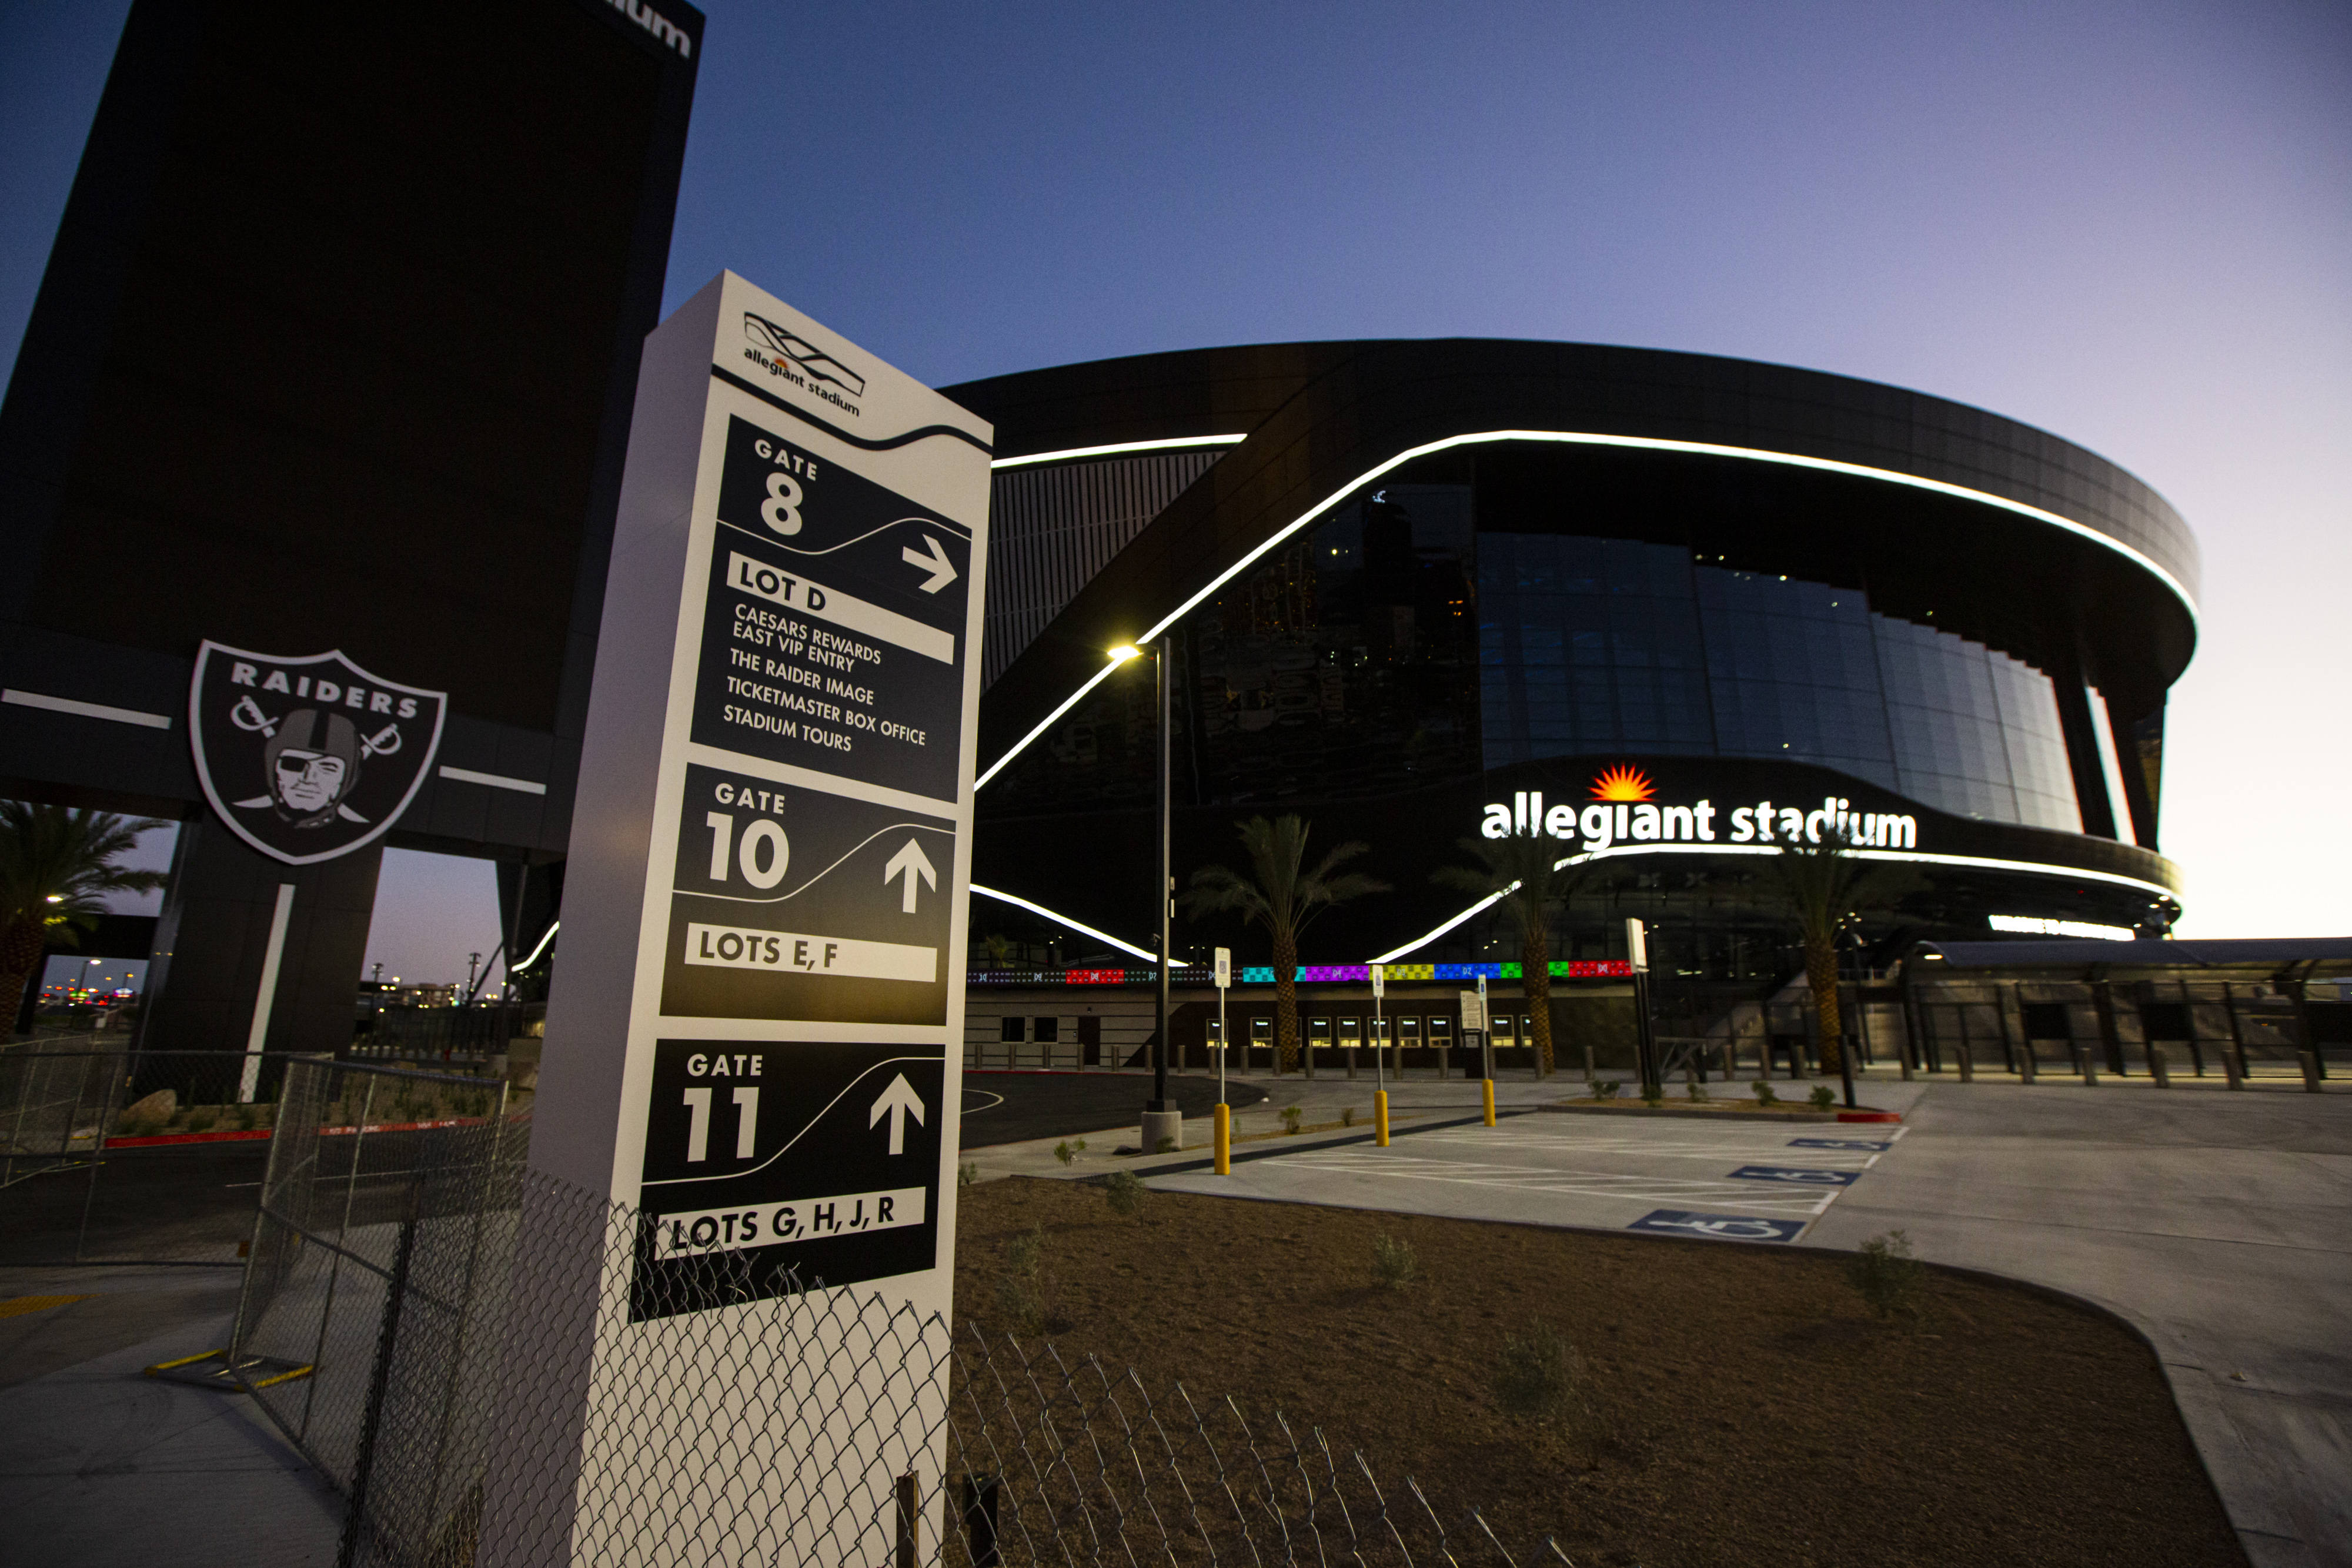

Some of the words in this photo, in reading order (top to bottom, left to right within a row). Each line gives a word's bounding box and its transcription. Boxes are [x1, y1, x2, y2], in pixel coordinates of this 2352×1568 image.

[744, 347, 804, 388] allegiant
[808, 380, 860, 417] stadium
[754, 439, 818, 482] GATE
[760, 472, 803, 536] 8
[740, 561, 797, 601] LOT
[807, 586, 826, 611] D
[733, 621, 773, 647] EAST
[778, 635, 804, 654] VIP
[808, 646, 855, 673] ENTRY
[735, 603, 808, 639] CAESARS
[813, 628, 882, 665] REWARDS
[230, 661, 419, 719] RAIDERS
[730, 648, 760, 671] THE
[766, 659, 821, 690] RAIDER
[826, 678, 874, 706] IMAGE
[723, 705, 797, 738] STADIUM
[802, 724, 852, 753] TOURS
[727, 676, 841, 723] TICKETMASTER
[845, 710, 876, 733] BOX
[880, 721, 926, 746] OFFICE
[715, 783, 786, 815] GATE
[1481, 791, 1716, 852] allegiant
[1729, 797, 1917, 848] stadium
[706, 811, 790, 890] 10
[700, 931, 780, 965] LOTS
[793, 940, 816, 971] E,
[824, 943, 838, 968] F
[687, 1054, 763, 1077] GATE
[683, 1086, 760, 1163] 11
[673, 1211, 759, 1251] LOTS
[772, 1207, 804, 1239] G,
[813, 1202, 843, 1234] H,
[850, 1199, 870, 1229] J,
[878, 1196, 895, 1223] R
